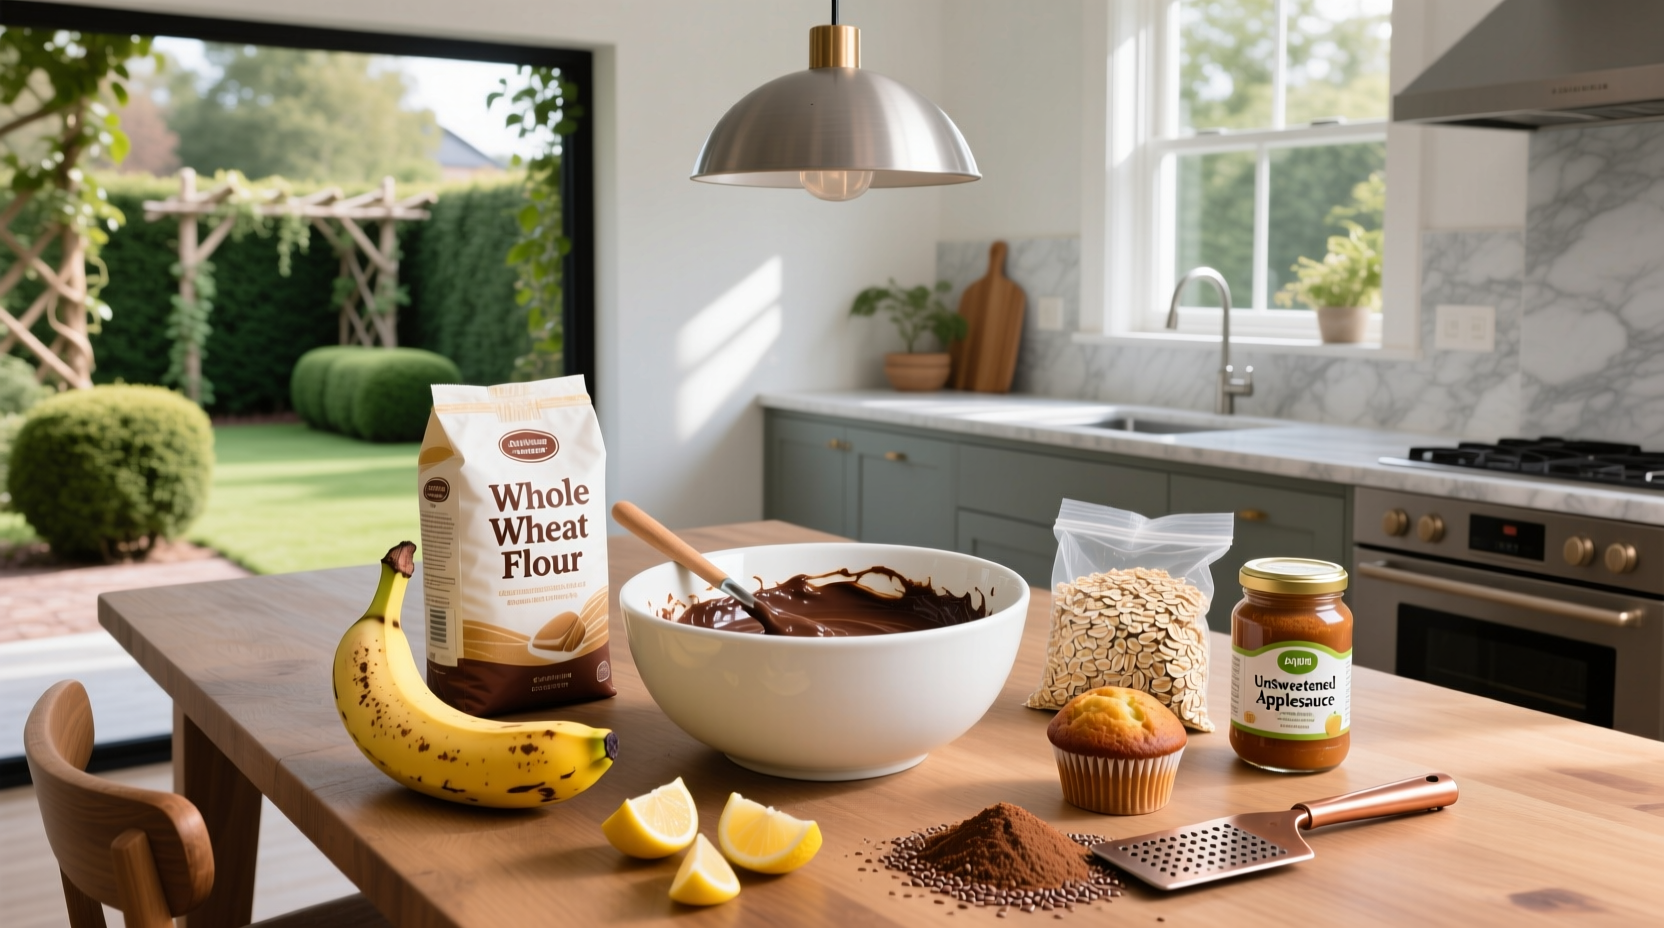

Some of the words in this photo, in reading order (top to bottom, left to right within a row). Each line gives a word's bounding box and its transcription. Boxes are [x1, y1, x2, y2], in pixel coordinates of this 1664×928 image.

[488, 477, 590, 512] Whole
[488, 513, 589, 547] Wheat
[501, 548, 583, 579] Flour
[1254, 674, 1336, 691] Unsweetened
[1255, 689, 1335, 711] Applesauce
